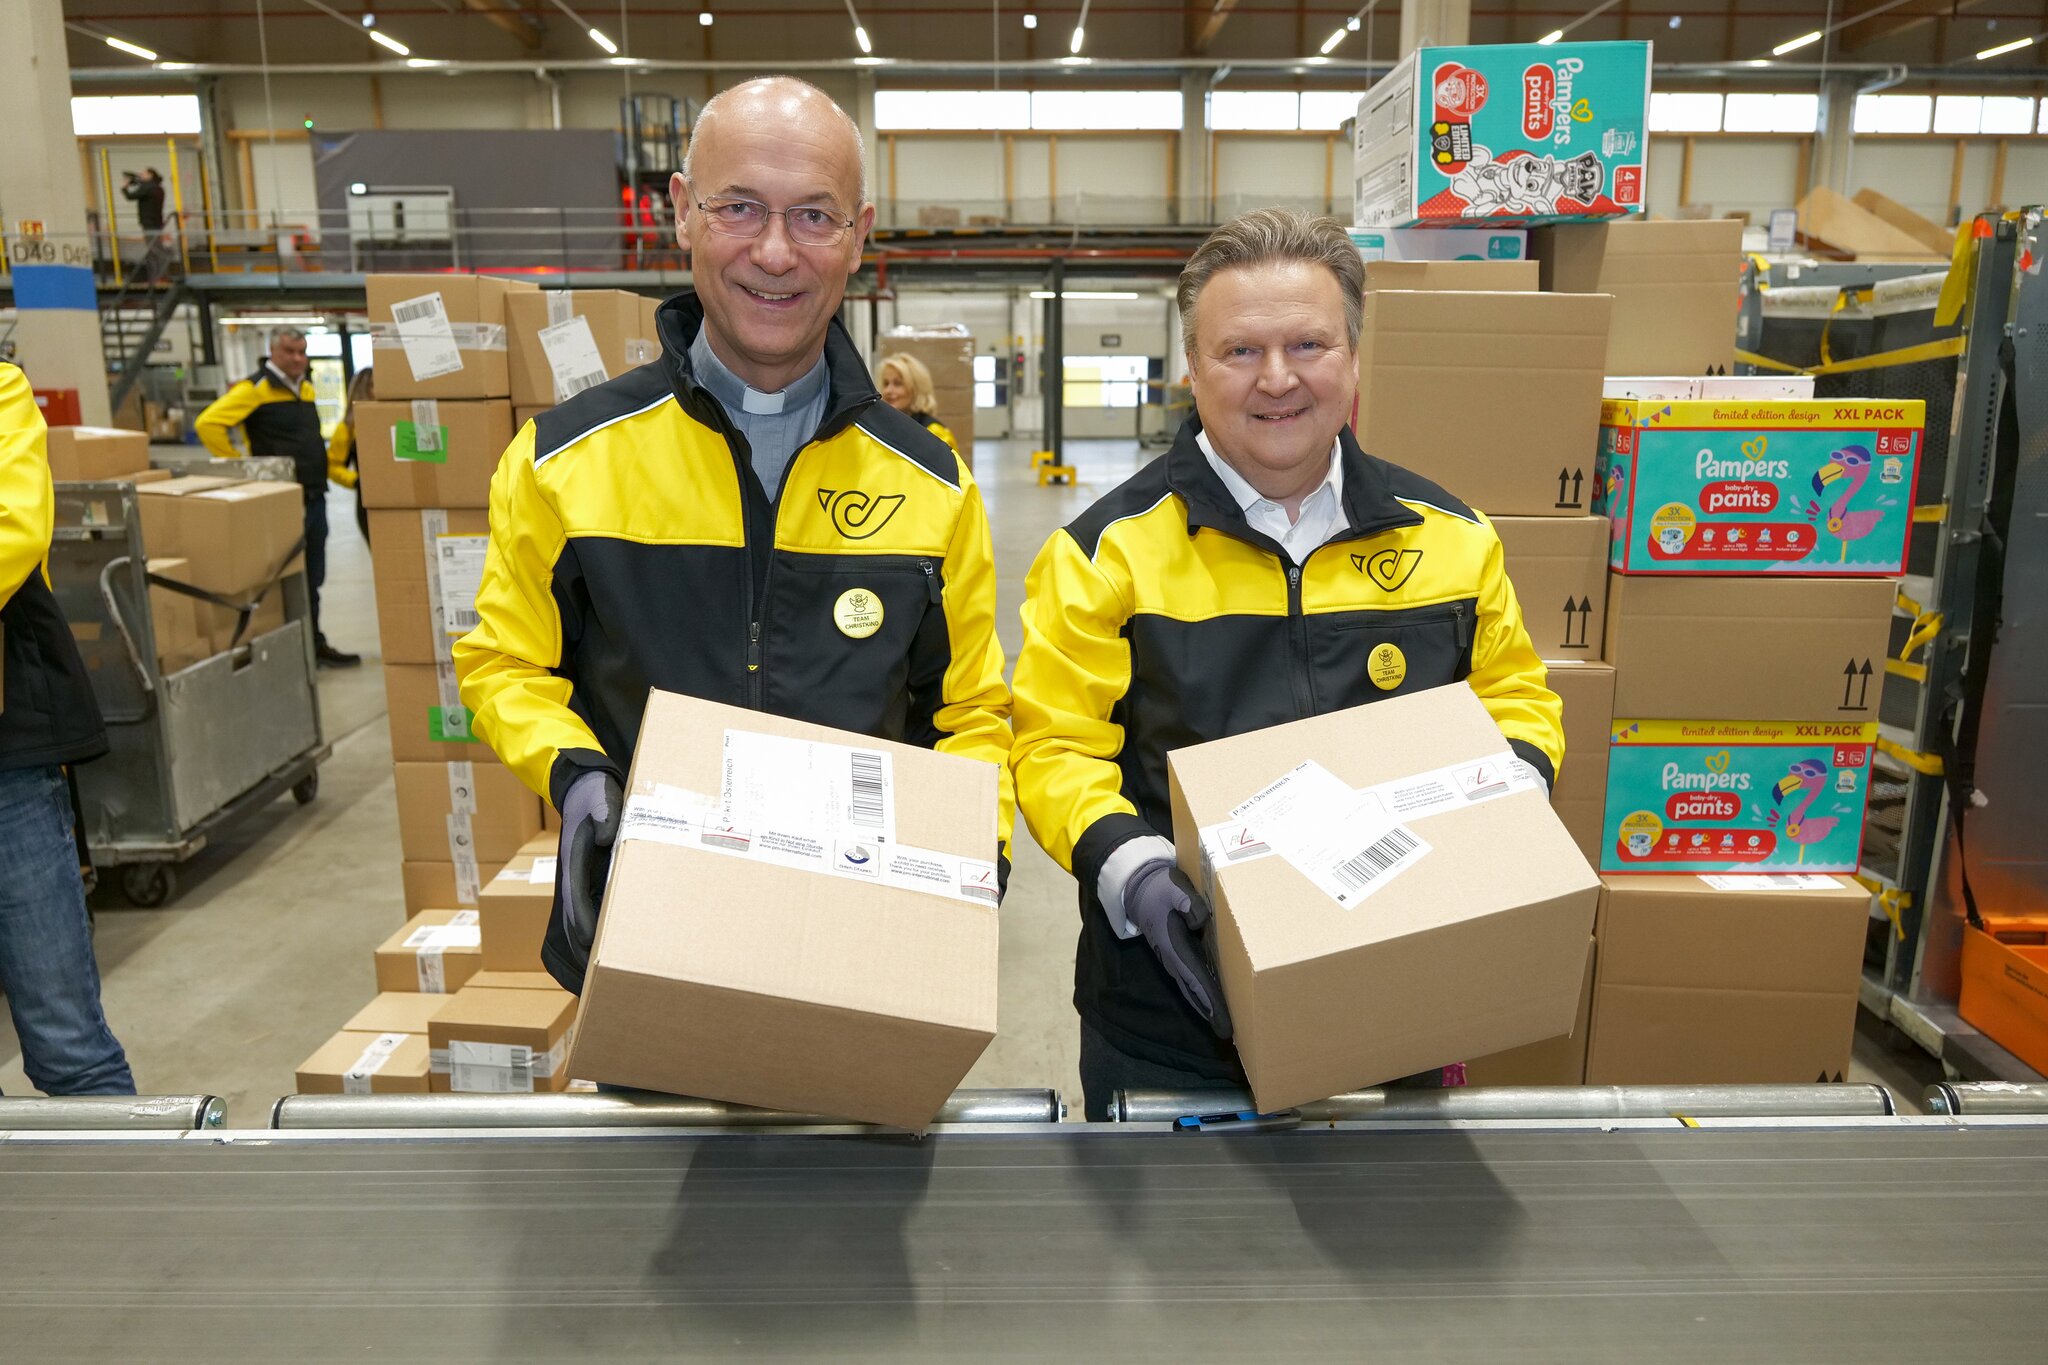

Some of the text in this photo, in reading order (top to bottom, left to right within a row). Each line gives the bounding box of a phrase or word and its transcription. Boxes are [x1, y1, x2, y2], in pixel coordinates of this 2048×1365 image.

[1526, 76, 1544, 130] pants
[1554, 58, 1584, 145] Pampers
[1451, 125, 1462, 160] EDITION
[1460, 124, 1471, 160] LIMITED
[1578, 154, 1595, 202] PAW
[1624, 171, 1635, 181] 4
[1492, 239, 1500, 250] 4
[13, 242, 56, 263] D49
[1713, 408, 1820, 423] limited edition design
[1833, 409, 1905, 420] XXL PACK
[1880, 436, 1888, 449] 5
[1696, 448, 1789, 483] Pampers
[1709, 490, 1771, 512] pants
[845, 621, 879, 629] CHRISTKIND
[1376, 674, 1402, 683] CHRISTKIND
[1682, 726, 1783, 739] limited edition design
[1795, 726, 1862, 736] XXL PACK
[1836, 751, 1844, 762] 5
[1662, 762, 1751, 793] Pampers
[1675, 800, 1734, 819] pants
[891, 869, 950, 883] www.pm-international.com
